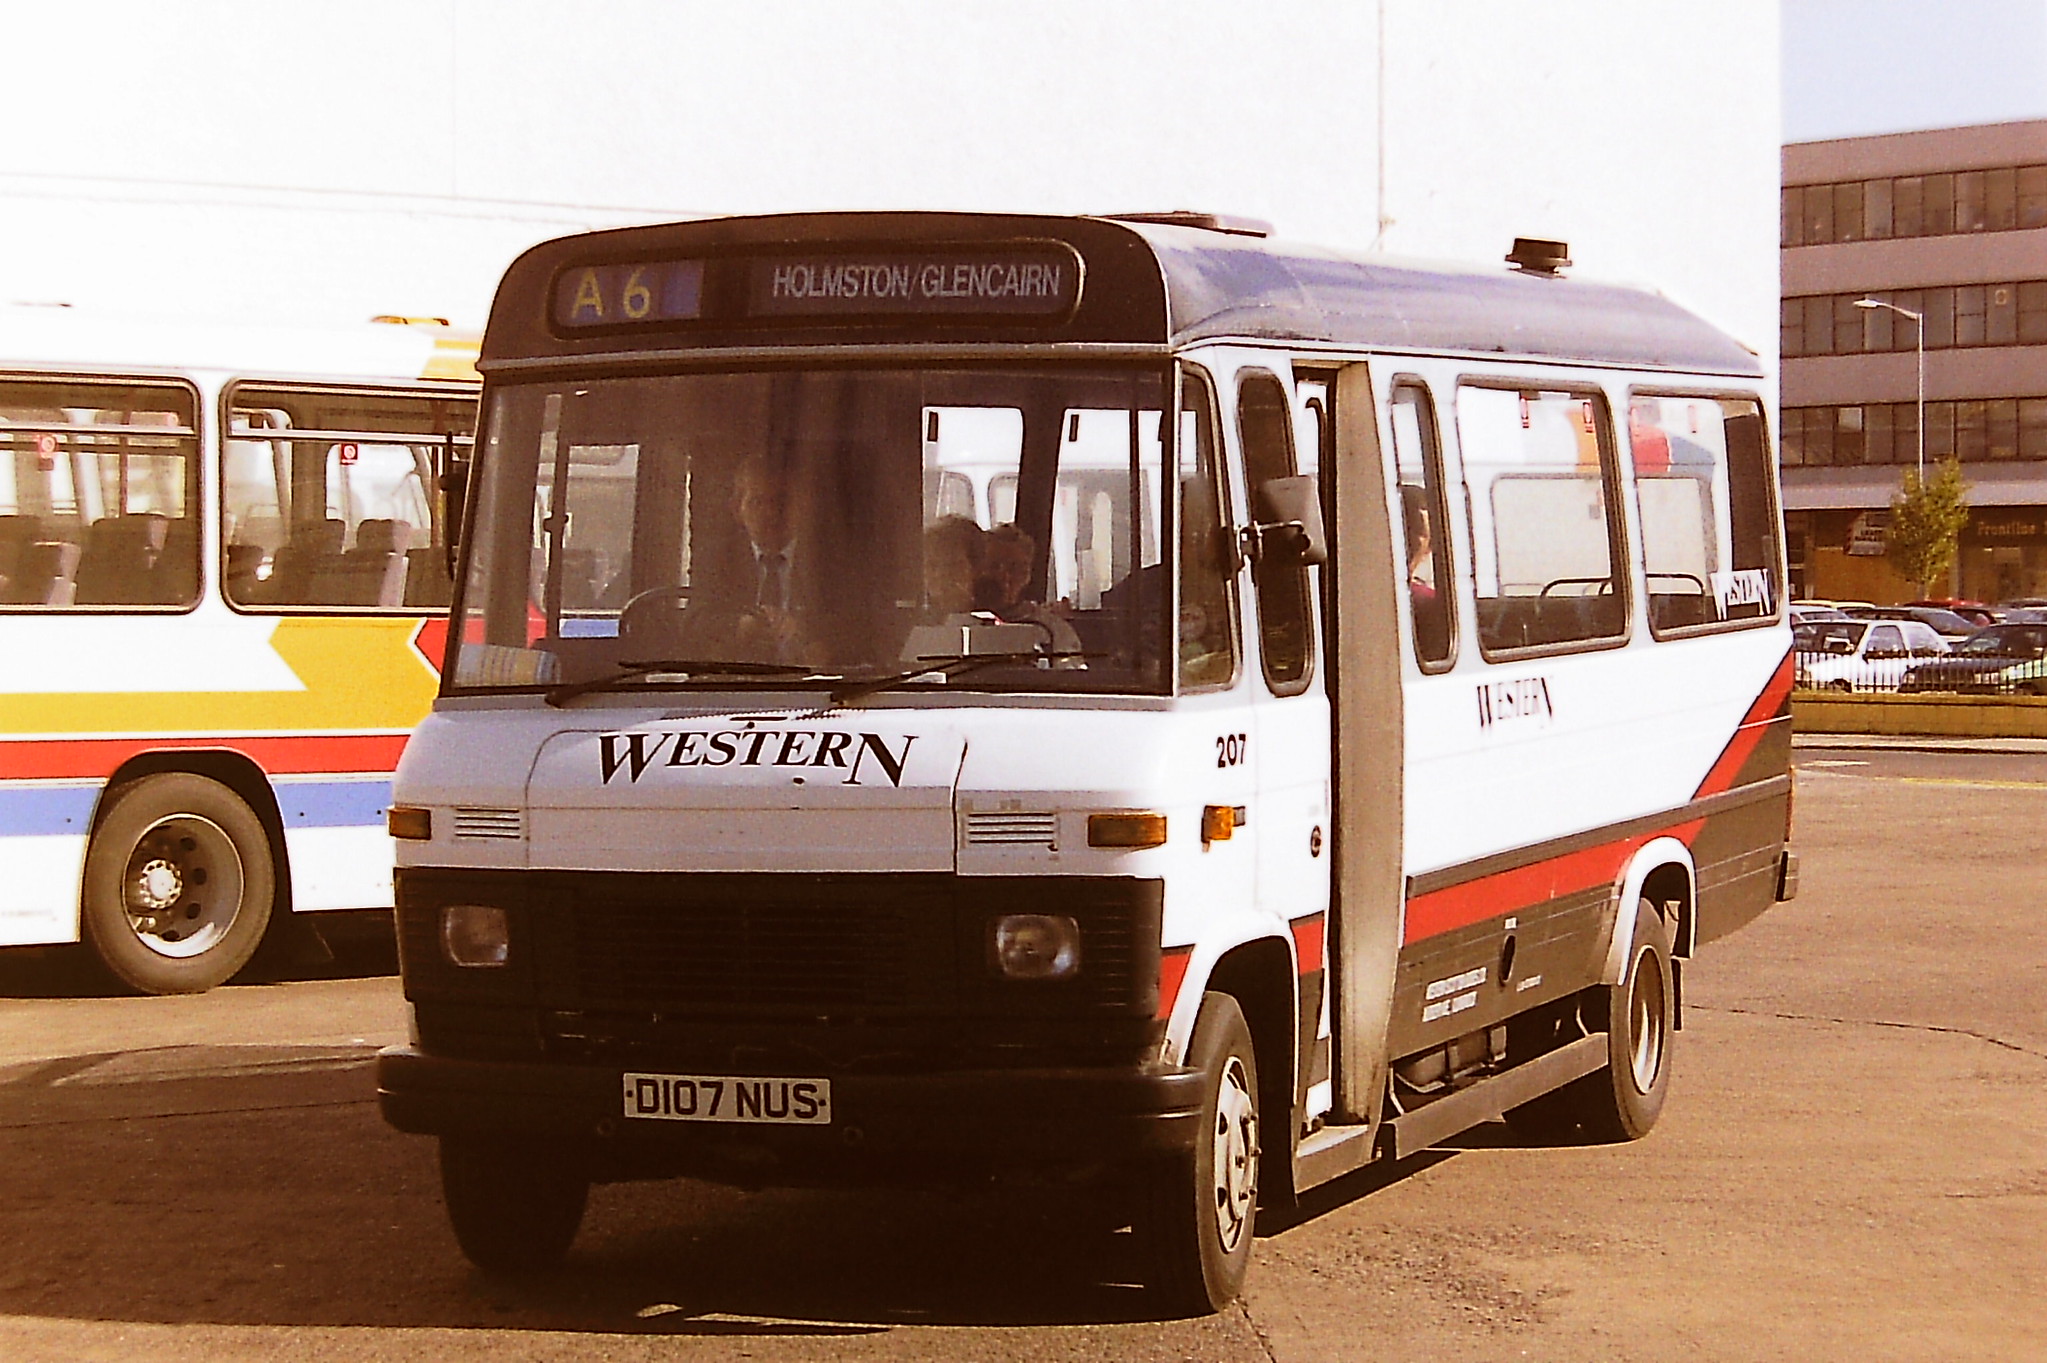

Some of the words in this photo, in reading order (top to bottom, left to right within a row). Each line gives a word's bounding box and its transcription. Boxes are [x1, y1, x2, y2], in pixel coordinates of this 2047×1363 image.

[570, 272, 604, 319] A
[622, 267, 652, 319] 6
[772, 262, 1061, 300] HOLMSTON/GLENCAIRN
[599, 730, 920, 788] WESTERN
[1215, 733, 1246, 768] 207
[635, 1078, 724, 1116] D107
[735, 1081, 819, 1119] NUS
